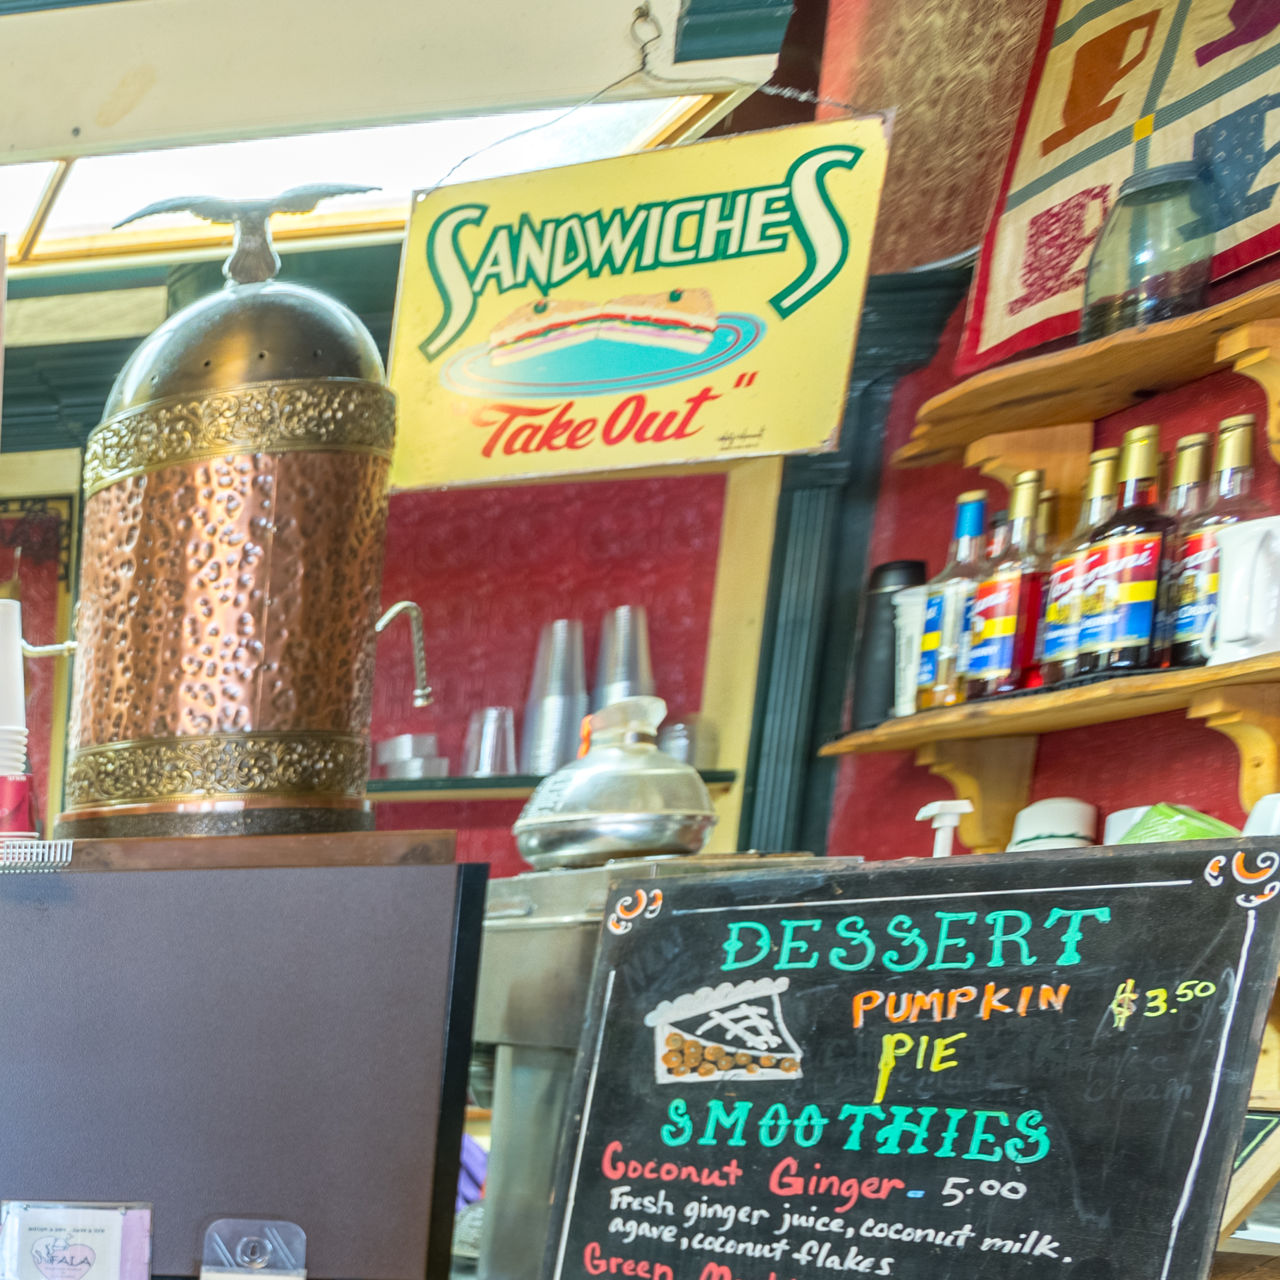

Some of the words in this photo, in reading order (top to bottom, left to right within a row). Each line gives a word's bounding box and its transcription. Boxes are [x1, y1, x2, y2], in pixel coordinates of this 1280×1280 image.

[418, 144, 864, 362] SANDWICHES
[471, 400, 596, 459] Take
[719, 906, 1112, 972] DESSERT
[852, 981, 1071, 1029] PUMPKIN
[872, 1032, 968, 1105] PIE
[660, 1097, 1052, 1165] SMOOTHIES
[601, 1140, 744, 1188] Coconut
[769, 1156, 906, 1214] Ginger
[941, 1176, 1028, 1208] 5.00
[609, 1186, 675, 1217] Fresh
[683, 1193, 771, 1233] ginger
[772, 1202, 855, 1240] juice,
[859, 1218, 977, 1249] coconut
[691, 1231, 791, 1262] coconut
[792, 1239, 896, 1277] flakes
